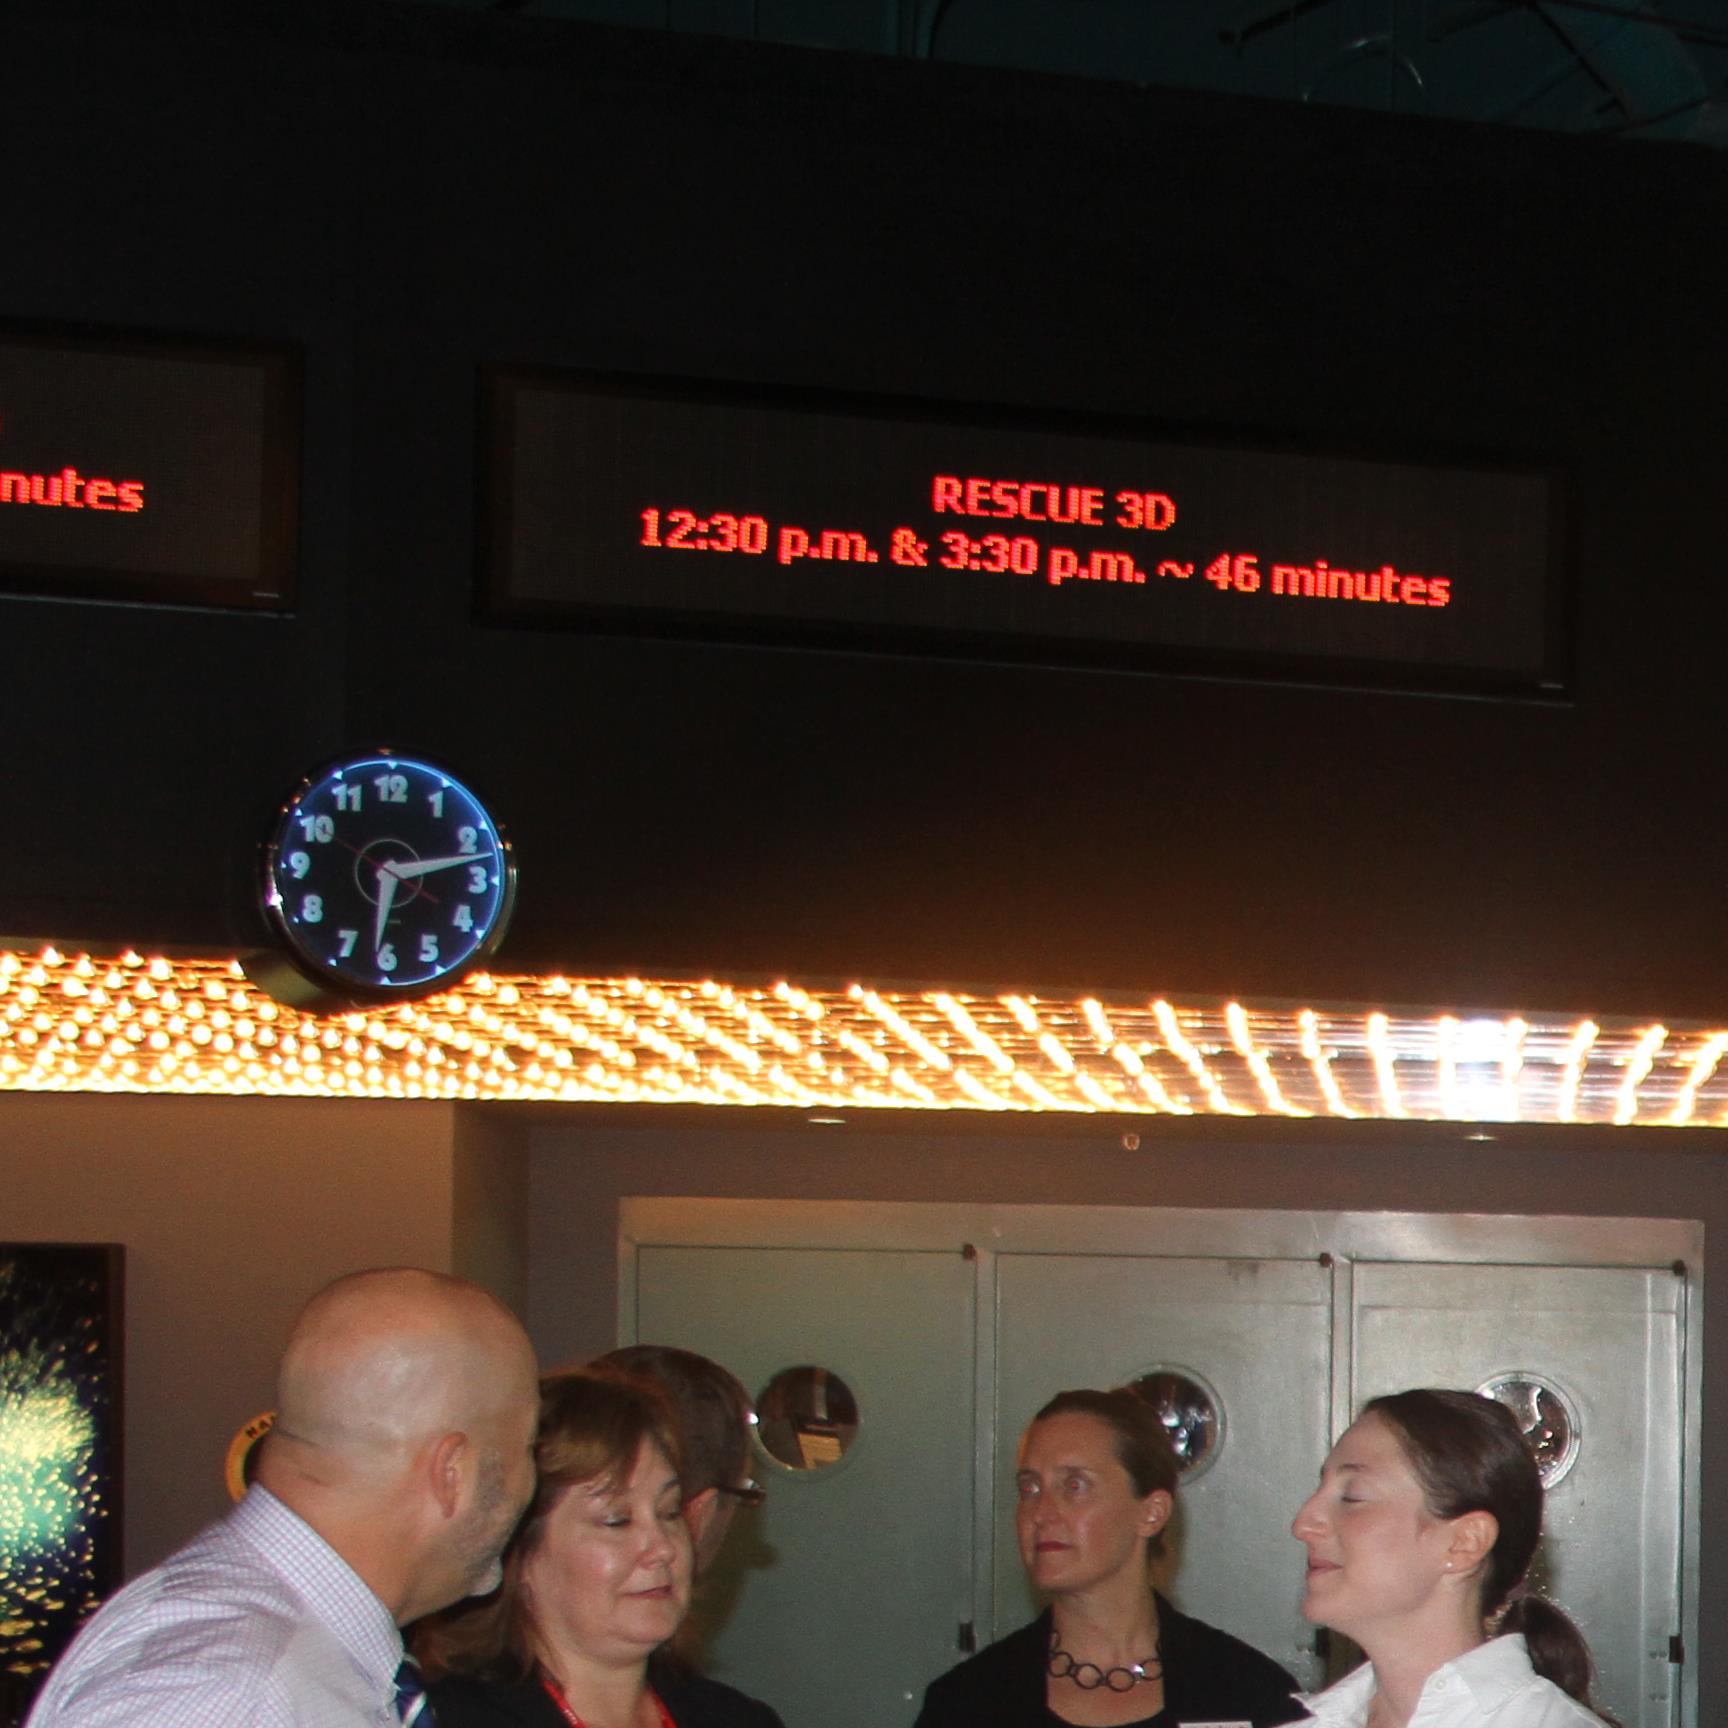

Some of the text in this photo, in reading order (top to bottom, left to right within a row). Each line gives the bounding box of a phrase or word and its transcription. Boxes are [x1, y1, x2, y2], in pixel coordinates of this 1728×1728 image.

[930, 474, 1177, 531] RESCUE 3D
[640, 508, 769, 555] 12:30
[777, 526, 879, 566] p.m.
[890, 527, 928, 567] &
[939, 531, 1039, 575] 3:30
[1046, 547, 1146, 586] p.m.
[1205, 553, 1261, 593] 46
[1270, 560, 1451, 607] minutes
[331, 784, 363, 812] 11
[374, 775, 409, 803] 12
[428, 791, 444, 818] 1
[300, 815, 336, 844] 10
[457, 826, 478, 854] 2
[289, 851, 311, 880] 9
[468, 866, 488, 894] 3
[302, 895, 323, 923] 8
[452, 905, 474, 932] 4
[337, 930, 358, 957] 7
[377, 943, 398, 971] 6
[418, 934, 439, 963] 5
